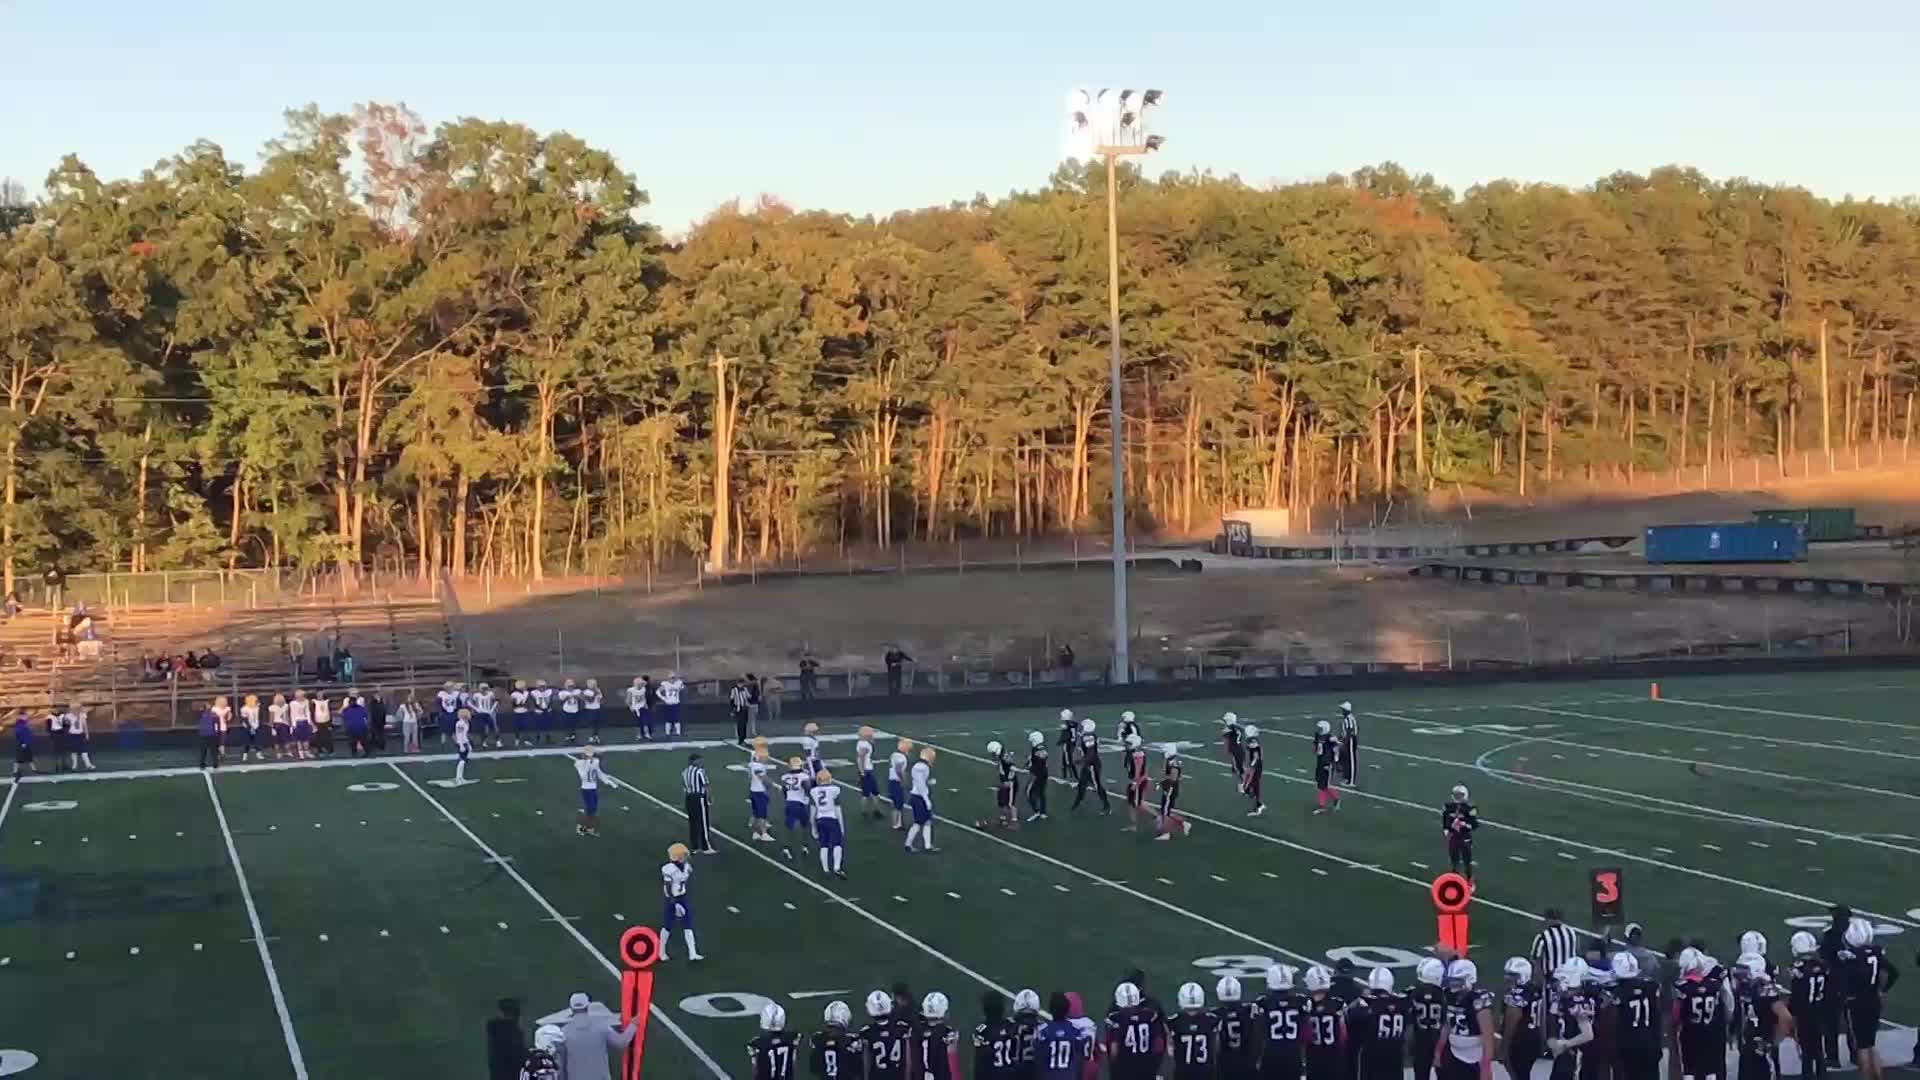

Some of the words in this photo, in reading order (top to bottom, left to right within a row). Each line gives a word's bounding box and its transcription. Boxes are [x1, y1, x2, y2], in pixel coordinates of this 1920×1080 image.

[818, 790, 827, 806] 2
[1596, 872, 1618, 903] 3
[1867, 955, 1878, 985] 7
[1269, 1010, 1299, 1040] 25
[1415, 1002, 1442, 1030] 29
[1629, 997, 1650, 1027] 71
[1691, 996, 1715, 1025] 59
[768, 1046, 789, 1078] 17
[873, 1039, 901, 1070] 24
[1050, 1040, 1081, 1069] 10
[1181, 1034, 1209, 1064] 73
